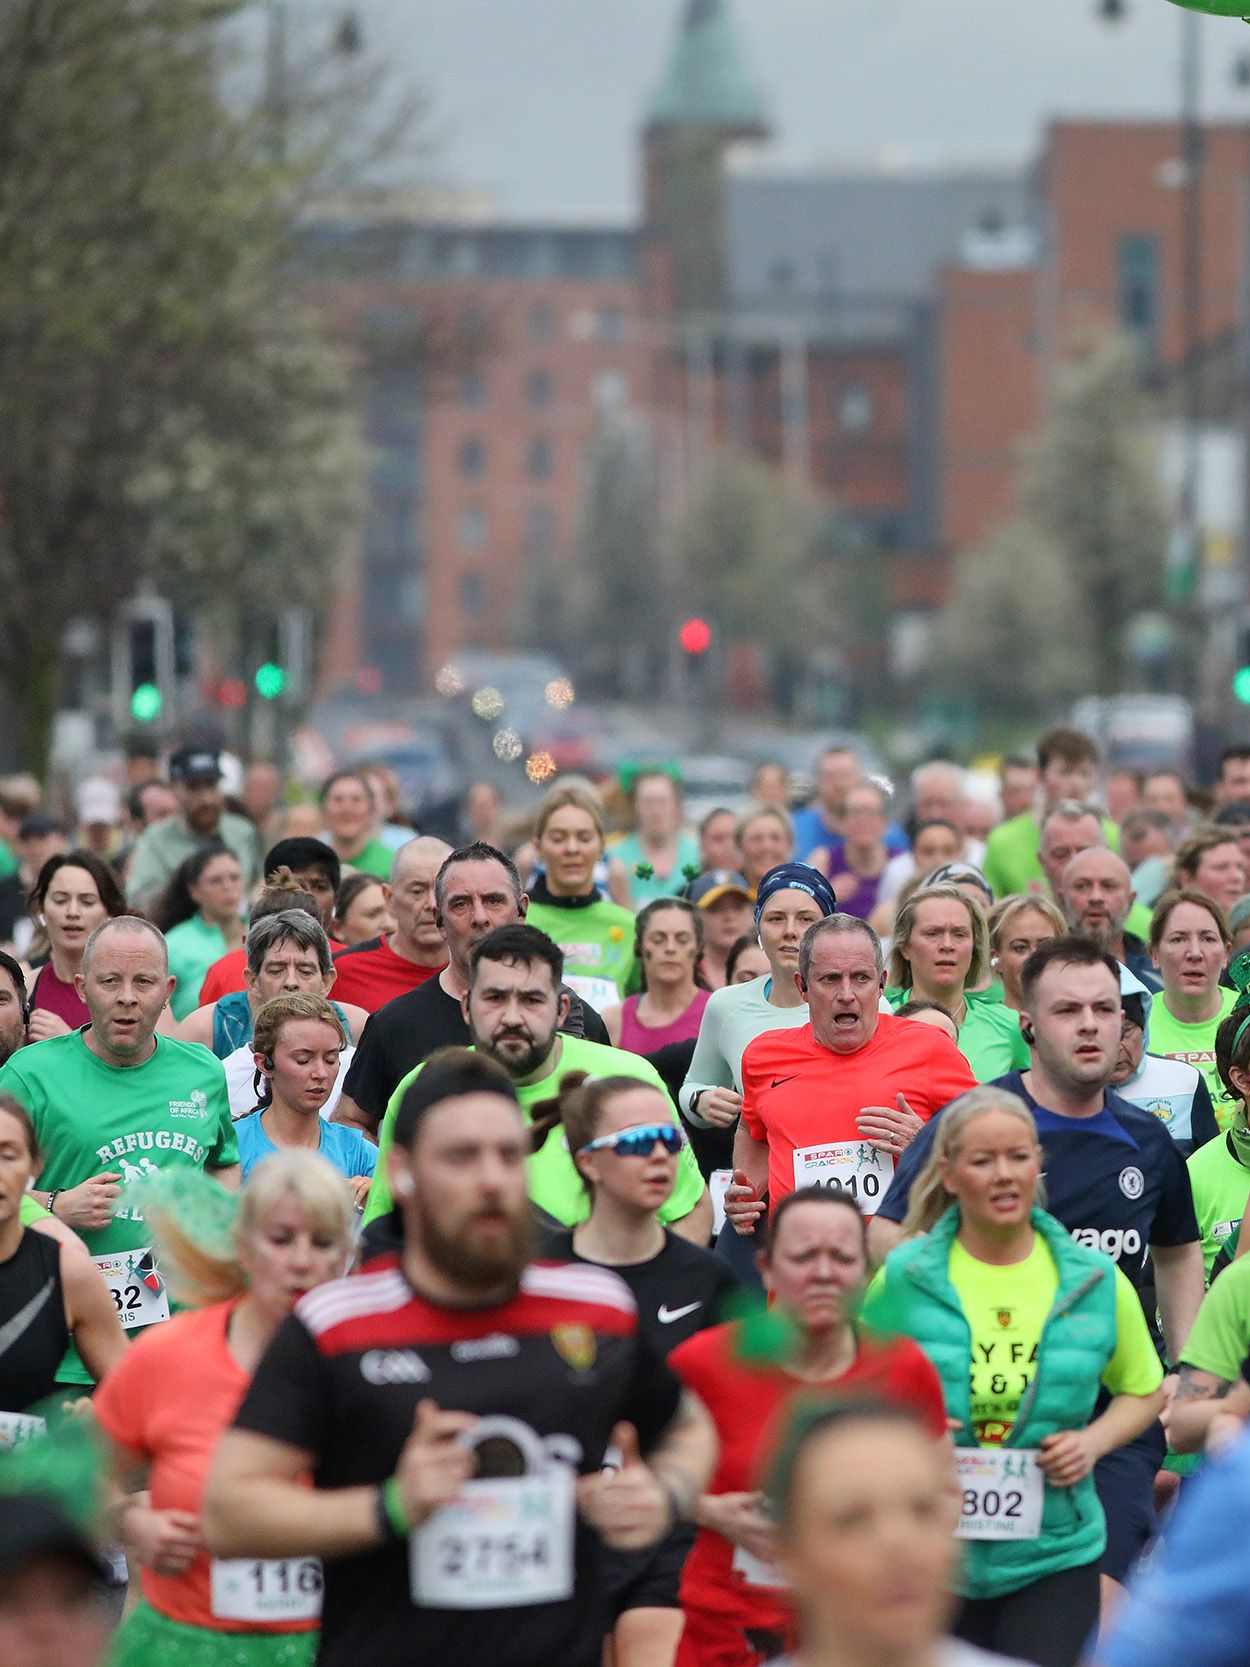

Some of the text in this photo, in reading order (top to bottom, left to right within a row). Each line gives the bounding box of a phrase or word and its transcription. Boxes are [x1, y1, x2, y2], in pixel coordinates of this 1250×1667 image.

[96, 1131, 205, 1166] REFUGEES
[810, 1149, 843, 1161] SPAR
[962, 1490, 1023, 1517] 802
[438, 1534, 549, 1577] 2754
